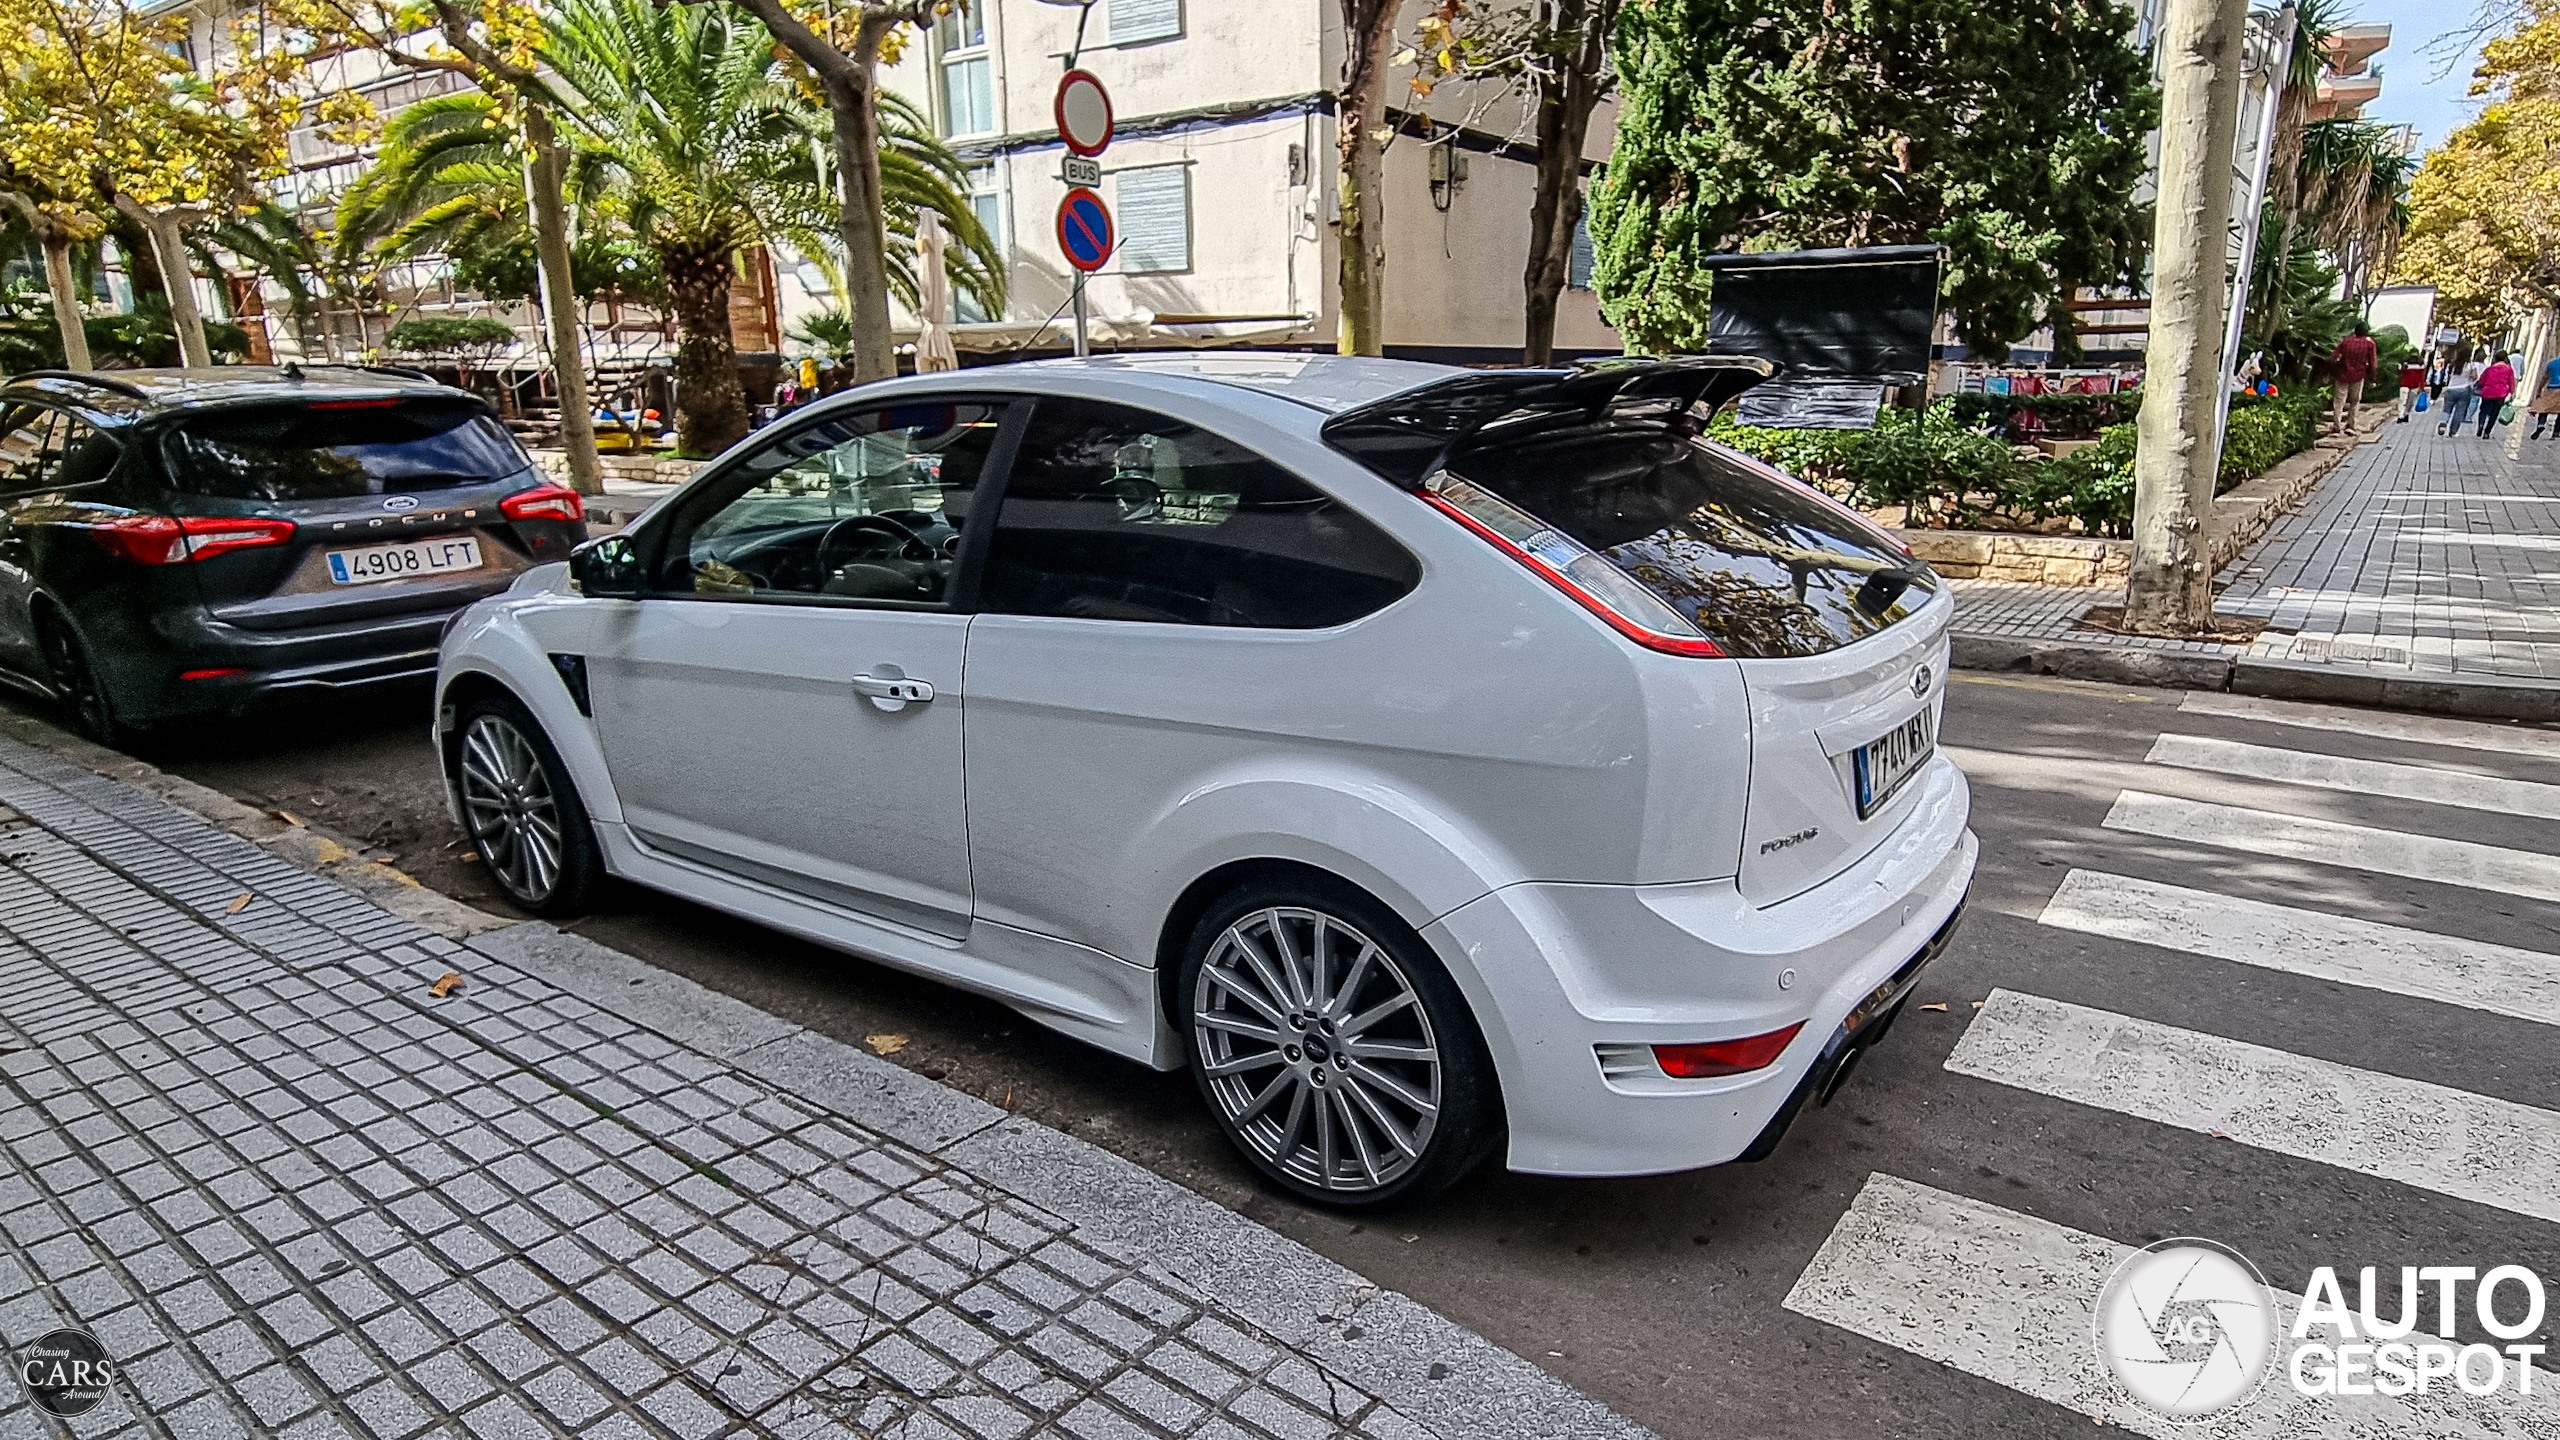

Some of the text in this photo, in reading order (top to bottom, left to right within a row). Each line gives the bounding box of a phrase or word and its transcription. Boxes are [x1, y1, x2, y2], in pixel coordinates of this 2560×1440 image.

[1069, 163, 1096, 180] BUS
[353, 542, 473, 577] 4908 LFT
[1871, 724, 1906, 791] 7740
